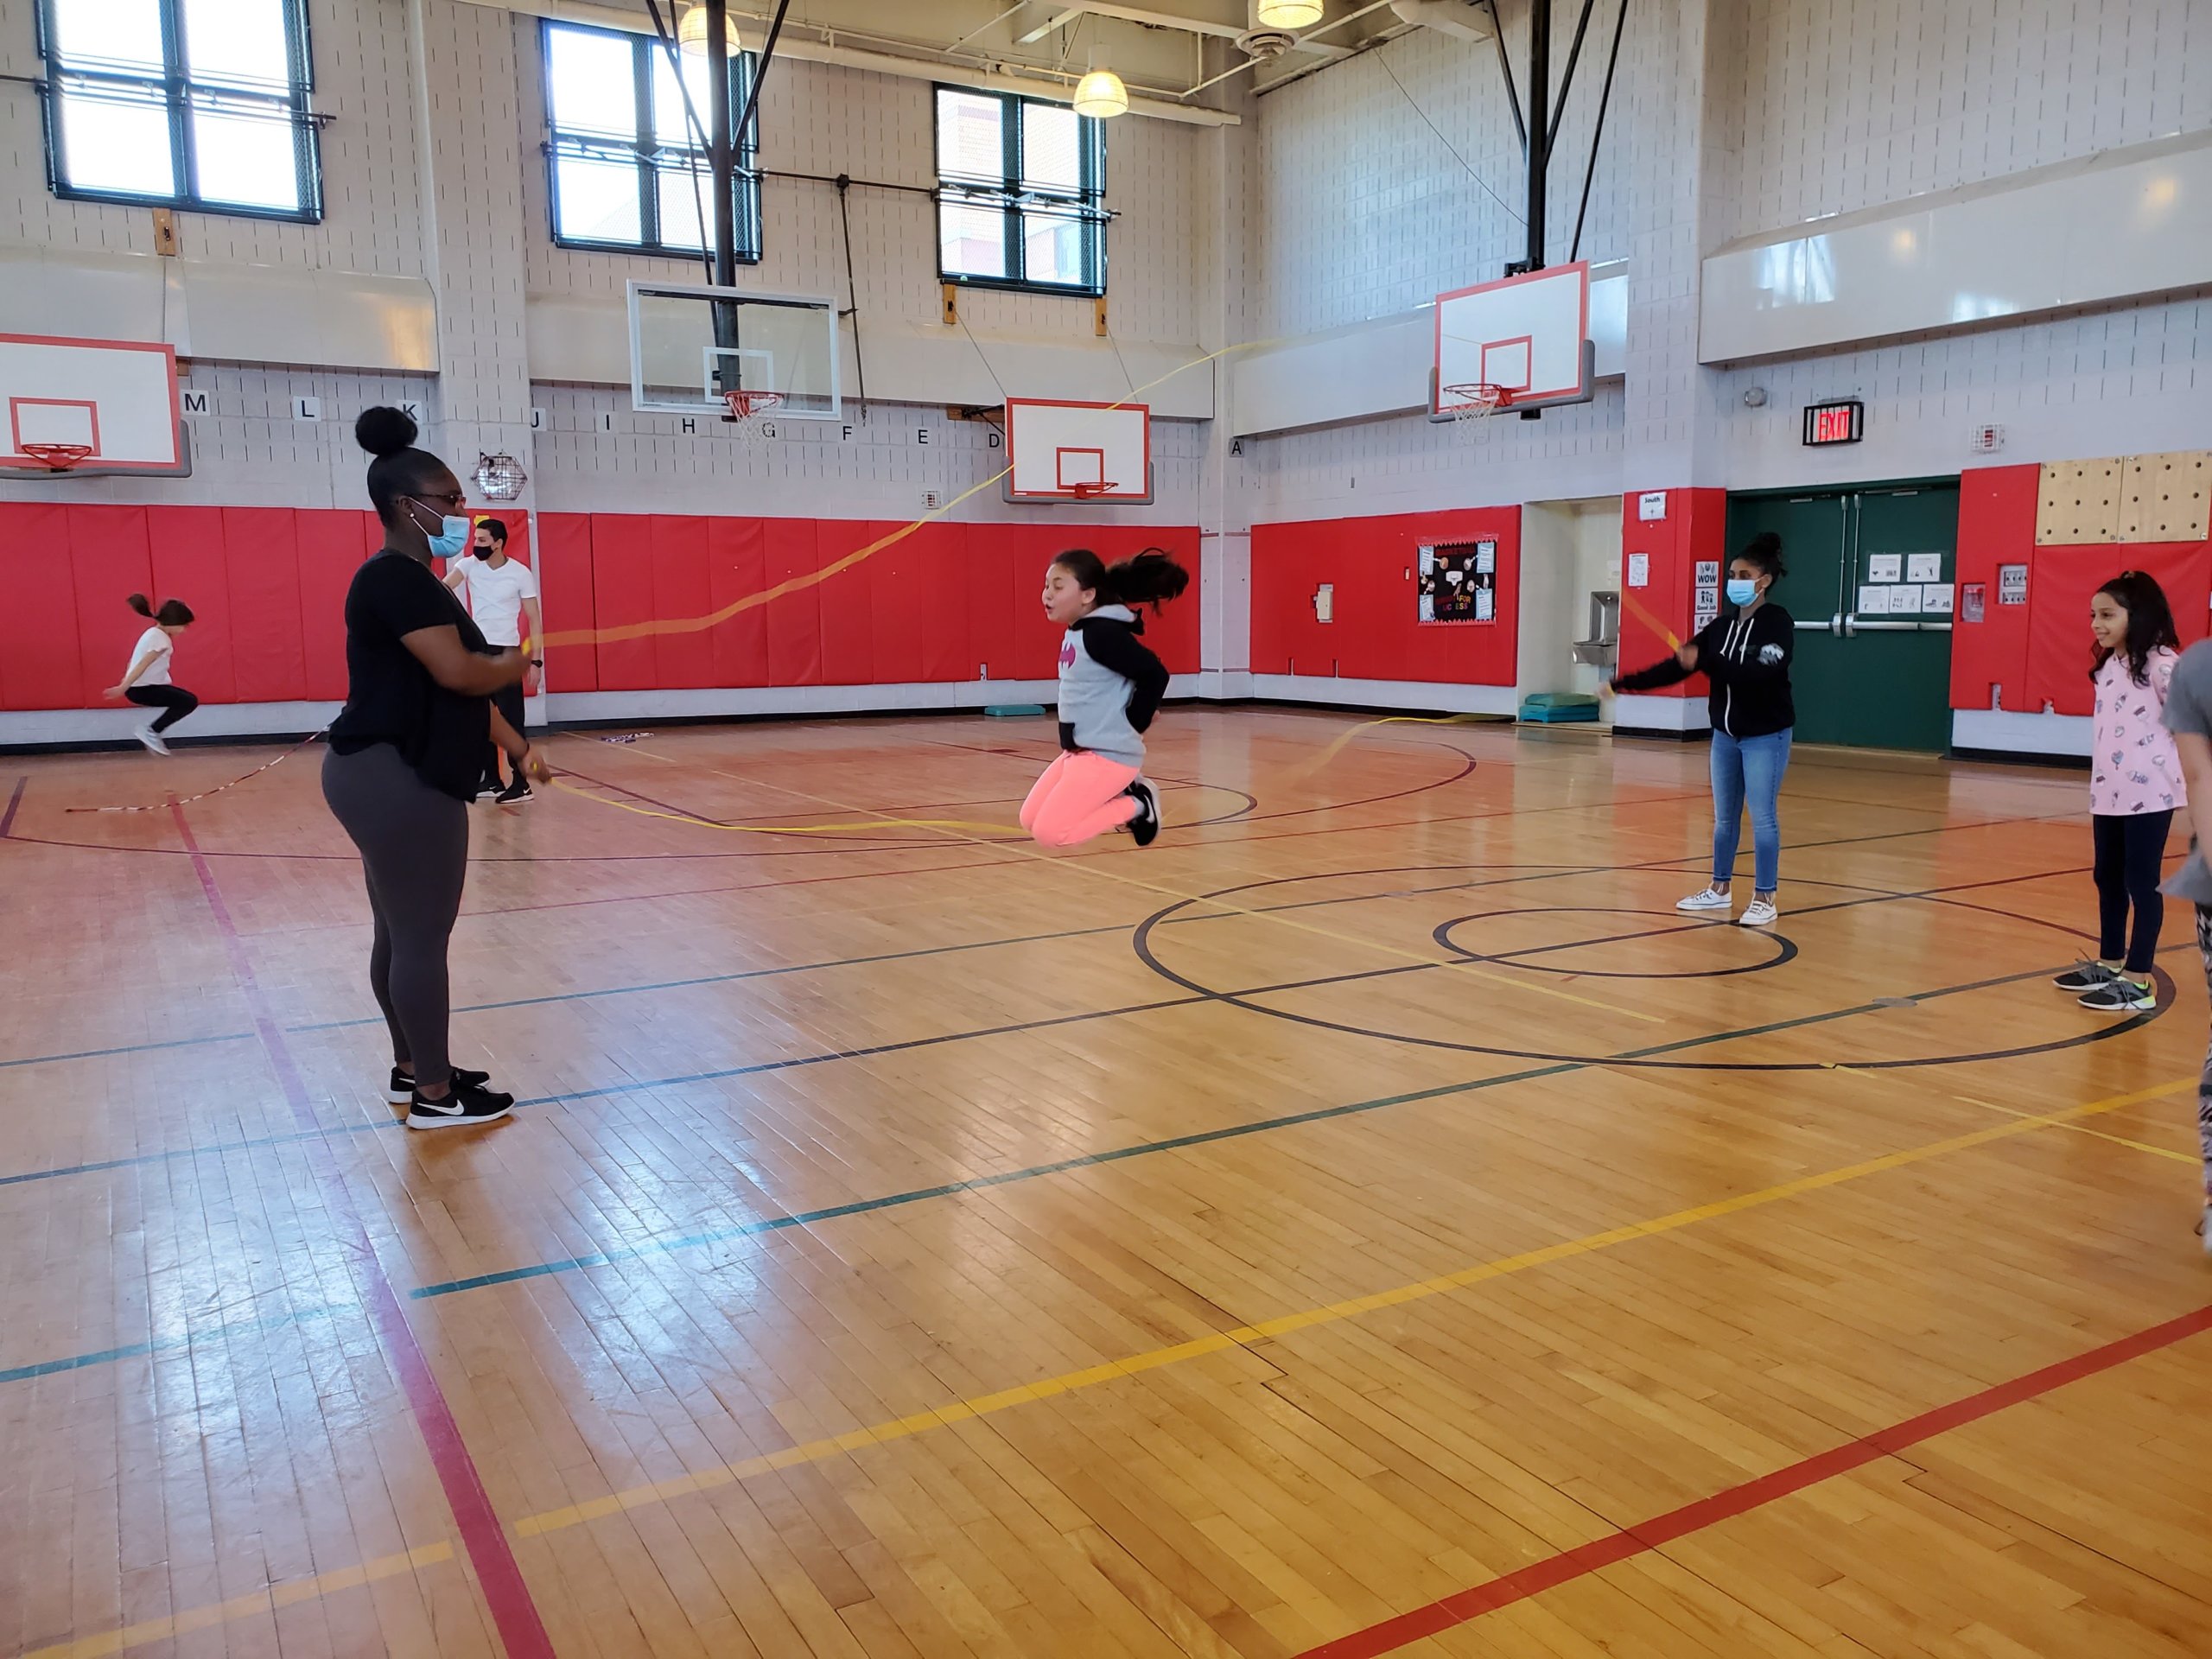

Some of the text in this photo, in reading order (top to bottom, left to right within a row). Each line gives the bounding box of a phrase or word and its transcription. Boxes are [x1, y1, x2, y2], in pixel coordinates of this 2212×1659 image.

[184, 393, 207, 412] M
[301, 399, 315, 418] L
[403, 404, 418, 421] K
[531, 411, 539, 429] J
[606, 414, 610, 430] I
[682, 417, 696, 434] H
[761, 422, 776, 438] G
[1818, 410, 1851, 442] EXIT
[842, 425, 853, 441] F
[918, 429, 929, 444] E
[988, 433, 1000, 448] D
[1231, 441, 1242, 455] A
[1697, 575, 1717, 583] WOW
